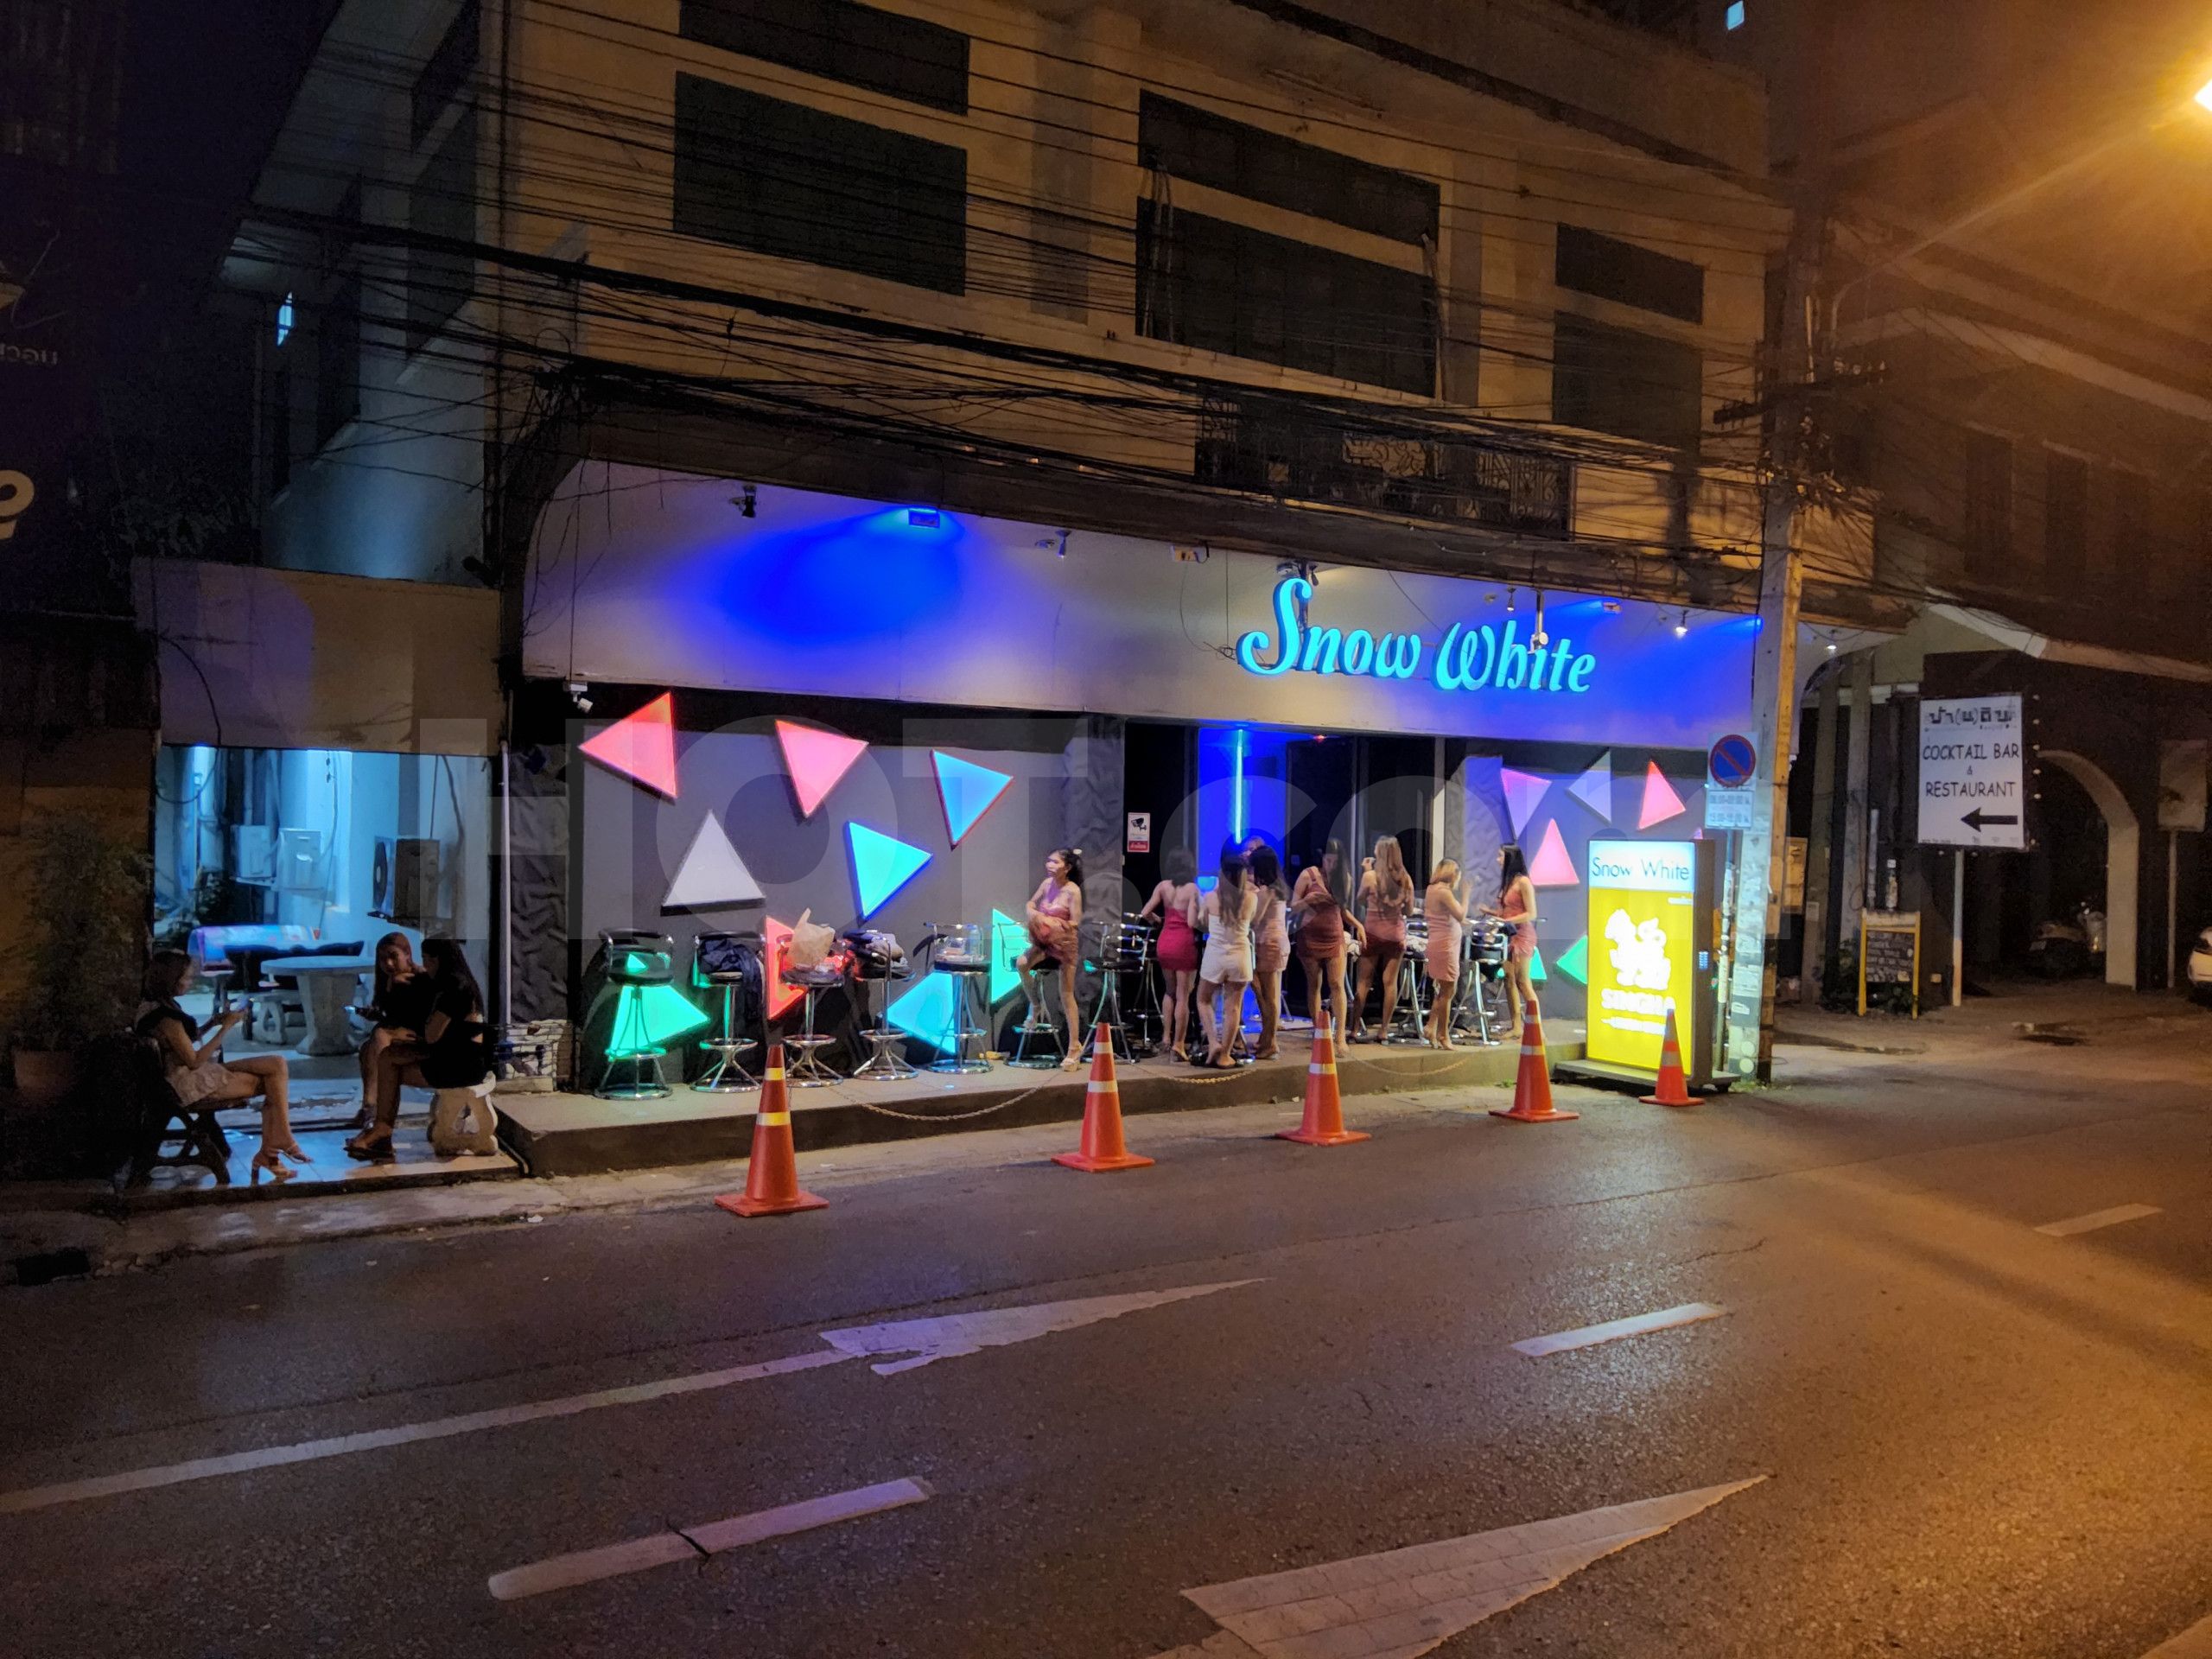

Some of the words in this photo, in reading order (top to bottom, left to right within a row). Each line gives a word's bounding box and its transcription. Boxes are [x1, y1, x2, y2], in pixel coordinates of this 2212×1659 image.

[1236, 577, 1422, 679] Snow
[1433, 620, 1597, 692] White
[1923, 744, 1987, 760] COCKTAIL
[1993, 743, 2019, 760] BAR
[1925, 780, 2016, 798] RESTAURANT
[1592, 856, 1631, 878] Snow
[1640, 857, 1689, 880] White
